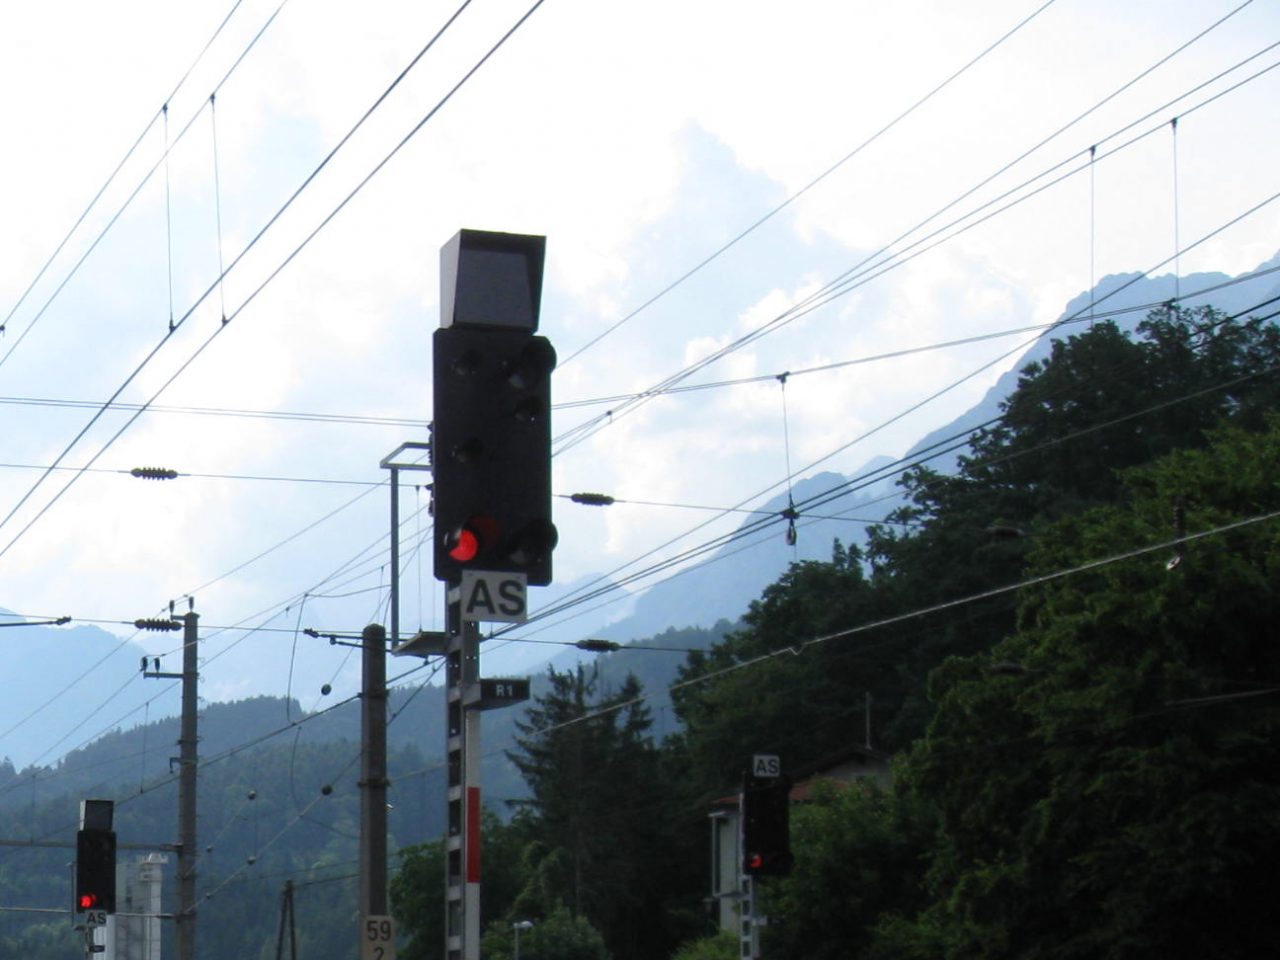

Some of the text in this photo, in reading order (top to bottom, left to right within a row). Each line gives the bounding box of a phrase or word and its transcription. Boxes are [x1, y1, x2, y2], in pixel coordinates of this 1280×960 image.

[466, 578, 525, 617] AS
[496, 684, 513, 697] R1
[757, 759, 778, 774] AS
[87, 912, 107, 925] AS
[368, 920, 391, 941] 59
